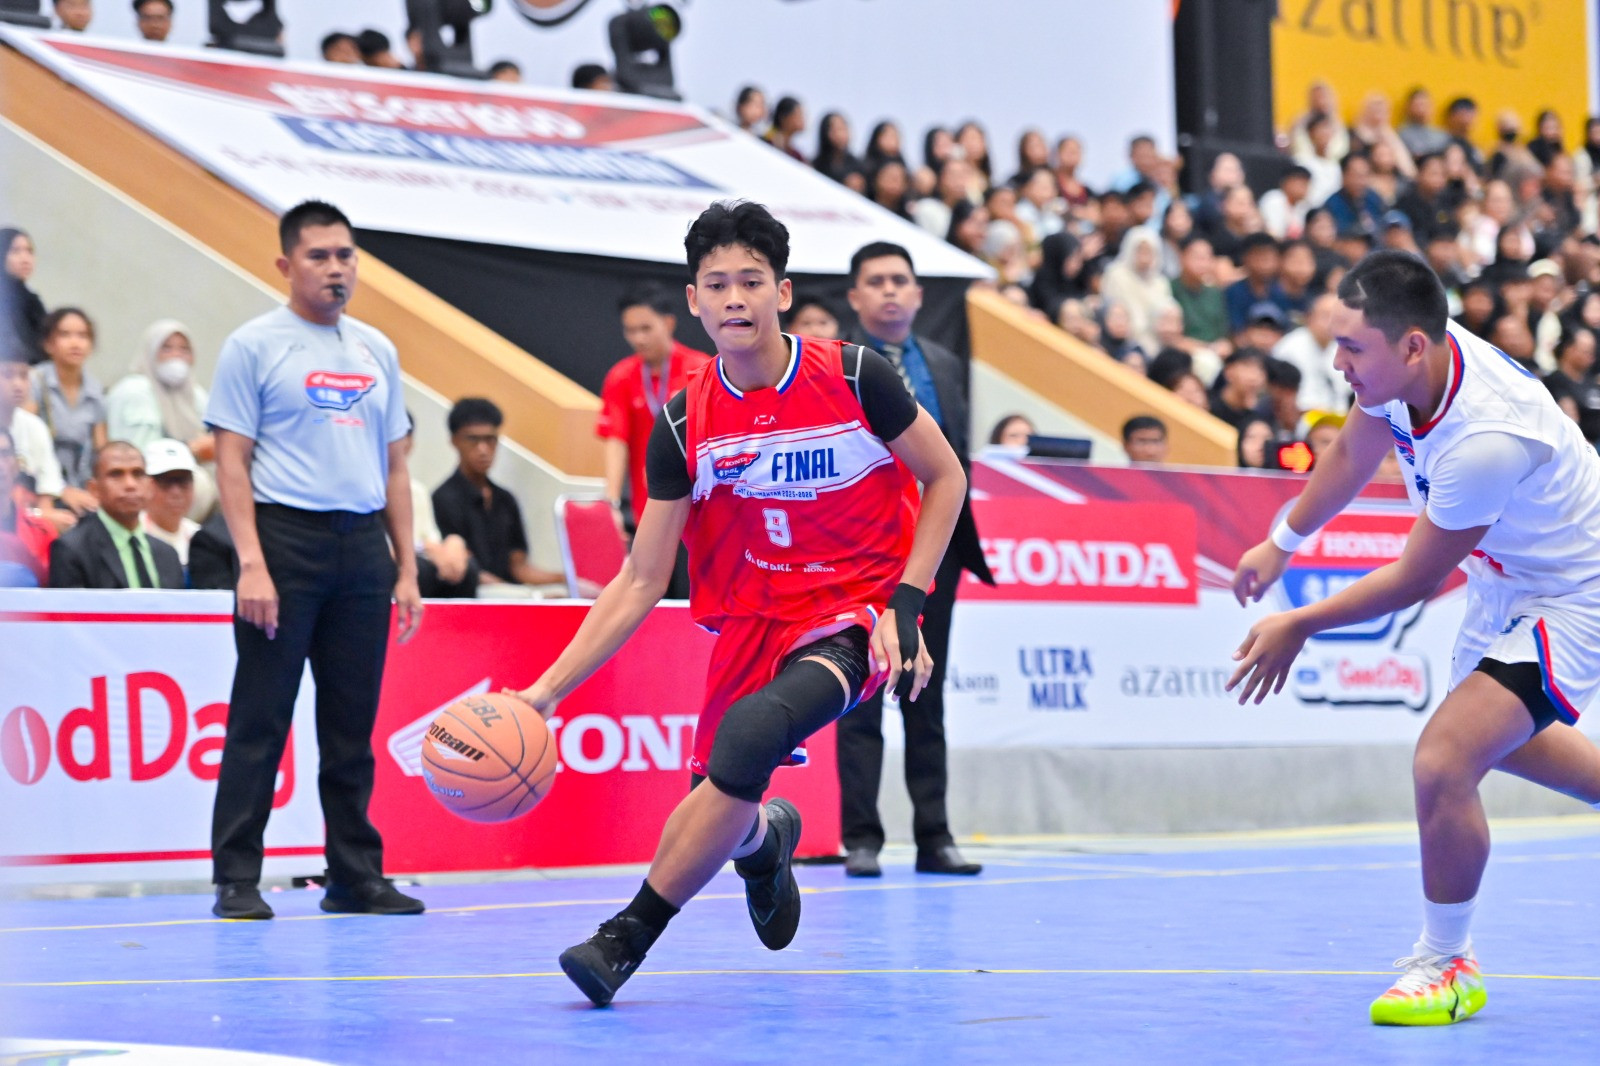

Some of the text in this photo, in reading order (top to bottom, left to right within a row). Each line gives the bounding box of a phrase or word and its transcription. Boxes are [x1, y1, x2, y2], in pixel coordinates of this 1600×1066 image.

[771, 448, 840, 483] FINAL
[762, 507, 793, 548] 9
[966, 536, 1190, 589] HONDA
[1017, 646, 1095, 678] ULTRA
[1026, 681, 1090, 711] MILK
